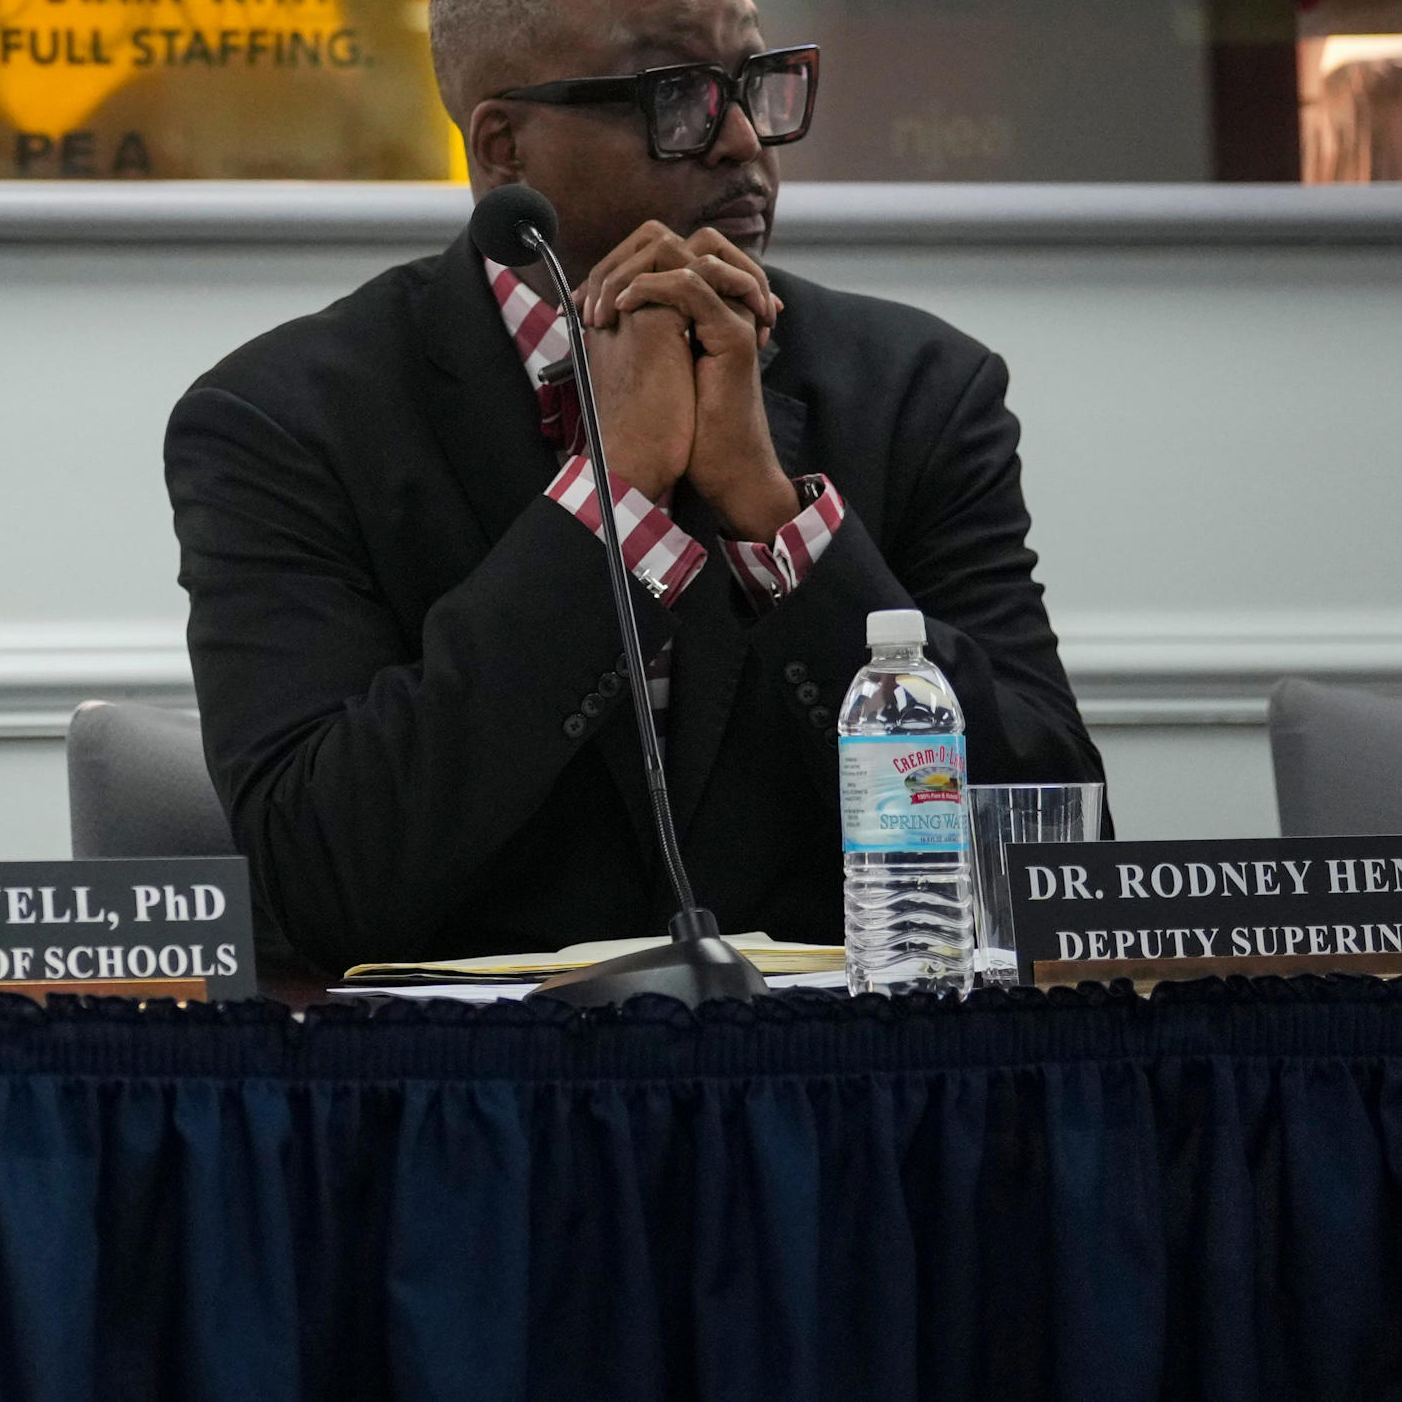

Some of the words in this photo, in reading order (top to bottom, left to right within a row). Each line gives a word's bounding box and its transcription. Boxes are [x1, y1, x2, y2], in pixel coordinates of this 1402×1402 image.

[0, 28, 112, 67] FULL
[131, 28, 377, 69] STAFFING.
[14, 132, 153, 175] PEA
[879, 813, 941, 830] SPRING
[1025, 865, 1104, 901] DR.
[1115, 860, 1312, 899] RODNEY
[131, 884, 227, 923] PhD
[1055, 928, 1219, 961] DEPUTY
[1230, 922, 1402, 957] SUPERIN
[44, 943, 238, 980] SCHOOLS
